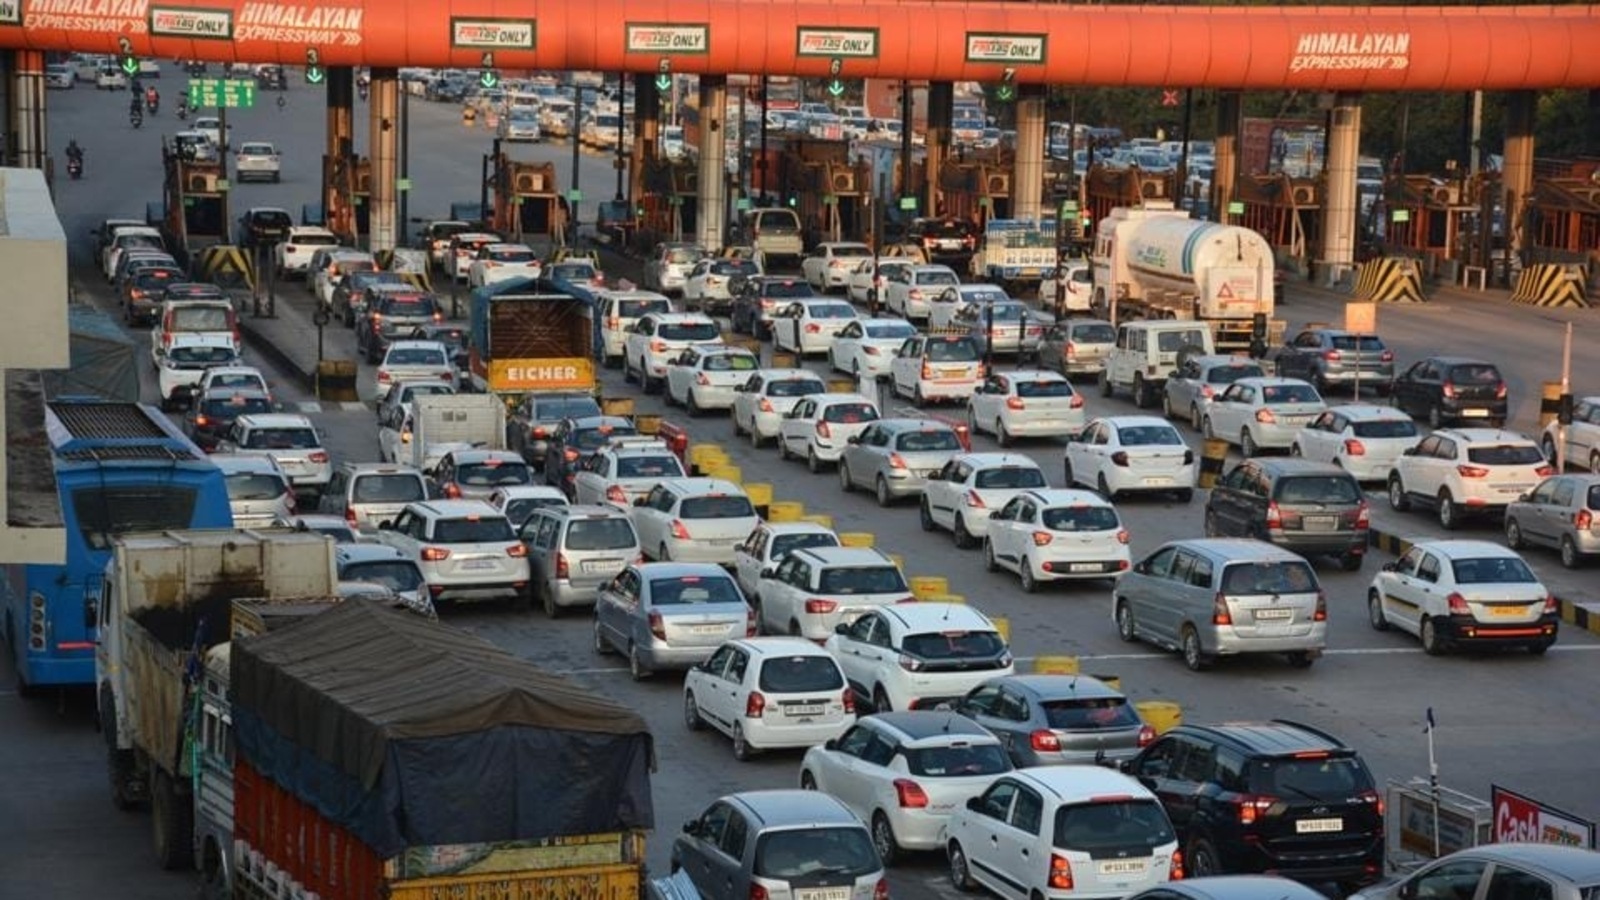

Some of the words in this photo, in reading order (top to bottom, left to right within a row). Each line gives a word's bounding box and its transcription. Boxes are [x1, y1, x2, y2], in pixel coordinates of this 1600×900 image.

[28, 0, 148, 17] HIMALAYAN
[240, 3, 362, 29] HIMALAYAN
[23, 14, 128, 33] EXPRESSWAY
[196, 19, 226, 32] ONLY
[233, 25, 340, 45] EXPRESSWAY
[499, 31, 528, 43] ONLY
[673, 35, 701, 47] ONLY
[119, 38, 132, 53] 2
[842, 39, 870, 51] ONLY
[1010, 44, 1039, 56] ONLY
[1297, 32, 1410, 54] HIMALAYAN
[307, 49, 317, 64] 3
[482, 53, 493, 67] 4
[660, 59, 670, 73] 5
[831, 60, 841, 74] 6
[1289, 55, 1389, 73] EXPRESSWAY
[1004, 68, 1015, 80] 7
[507, 366, 578, 381] EICHER
